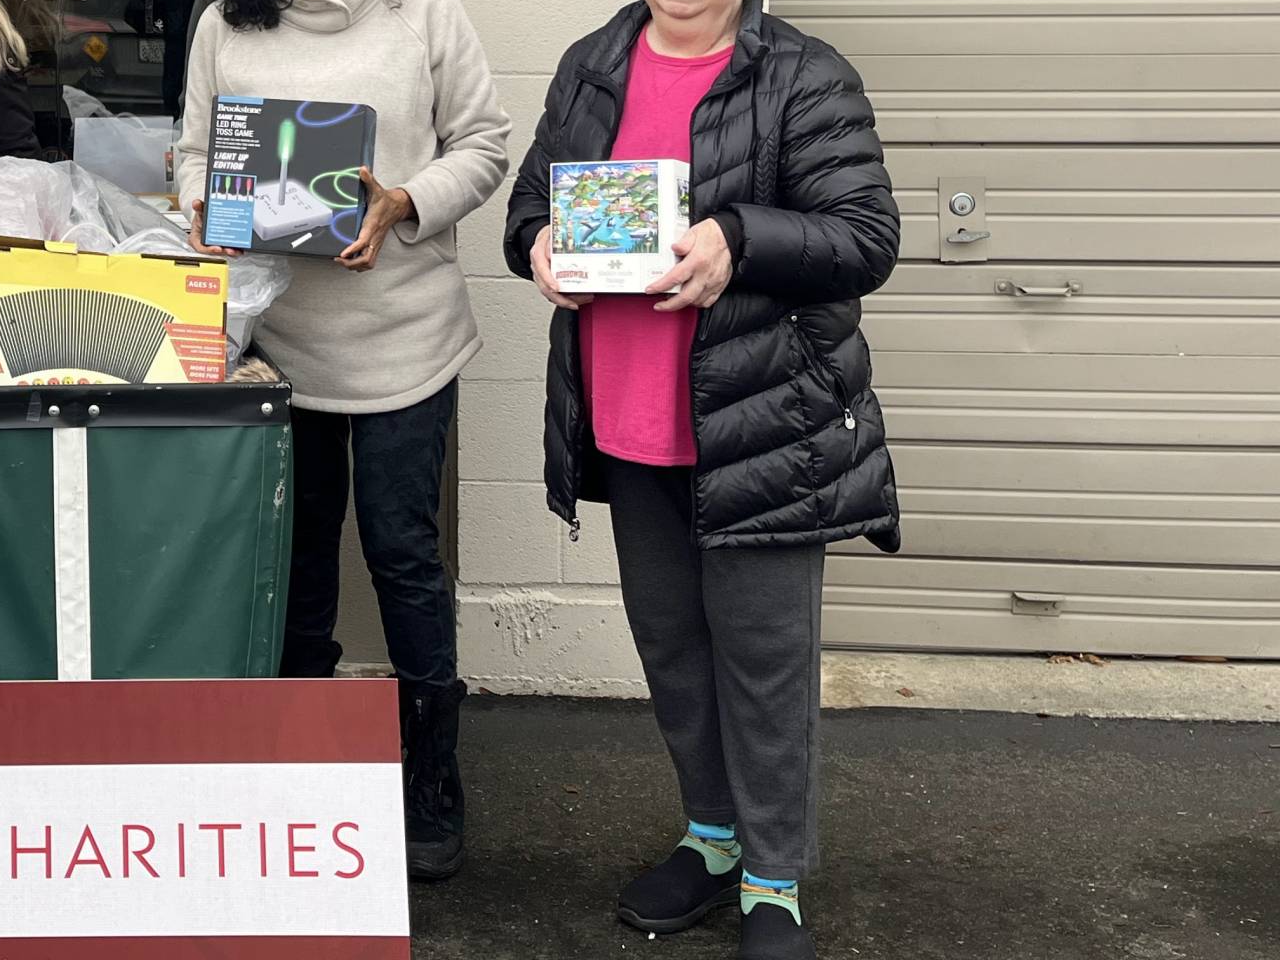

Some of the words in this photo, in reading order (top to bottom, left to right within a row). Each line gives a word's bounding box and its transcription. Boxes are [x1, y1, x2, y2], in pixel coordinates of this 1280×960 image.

[217, 103, 261, 114] Brookstone
[216, 120, 229, 128] LED
[231, 121, 247, 129] RING
[216, 128, 233, 136] TOSS
[234, 129, 254, 137] GAME
[214, 152, 237, 160] LIGHT
[238, 153, 249, 161] UP
[213, 161, 245, 170] EDITION
